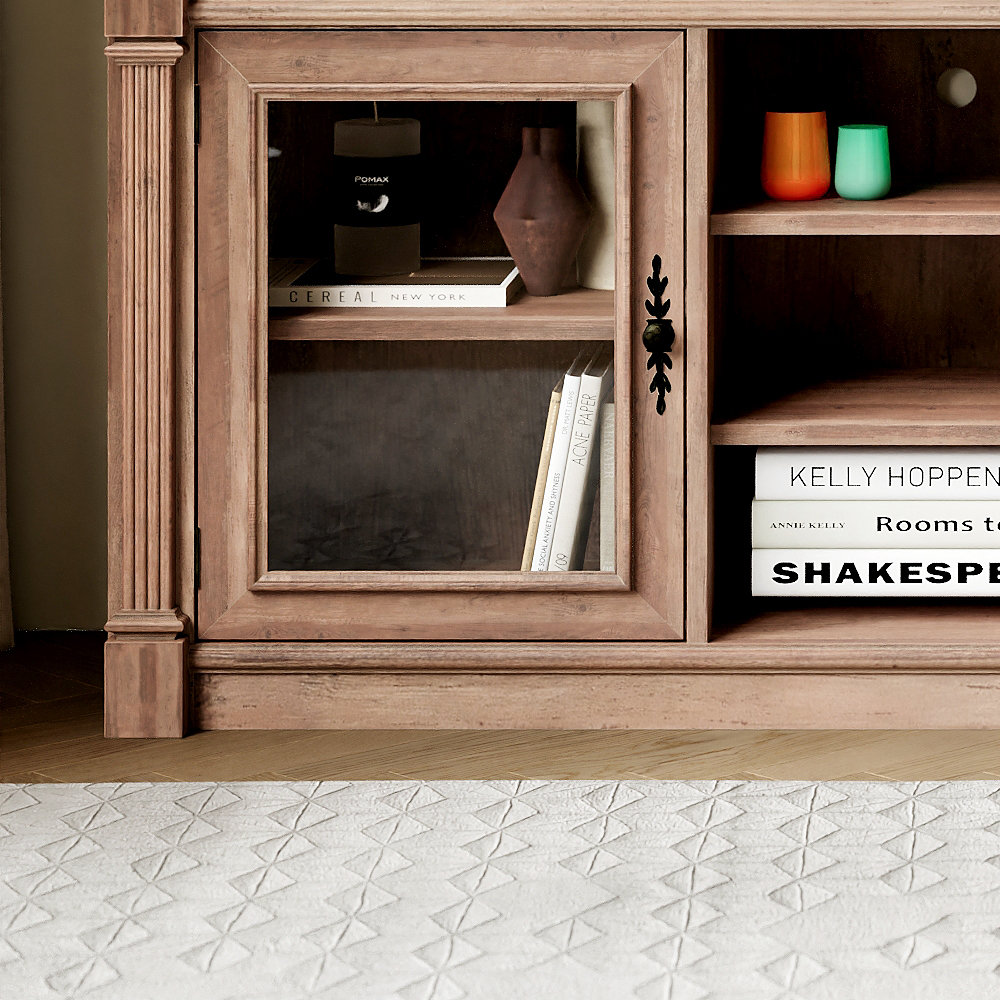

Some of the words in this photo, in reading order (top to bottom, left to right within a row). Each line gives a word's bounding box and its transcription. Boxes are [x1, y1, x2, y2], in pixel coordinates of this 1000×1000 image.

[289, 290, 377, 303] CEREAL
[391, 293, 422, 301] NEW
[429, 293, 466, 301] YORK
[577, 393, 597, 427] PAPER
[572, 431, 590, 467] ACNE
[789, 466, 877, 488] KELLY
[548, 501, 556, 515] AND
[876, 516, 974, 533] Rooms
